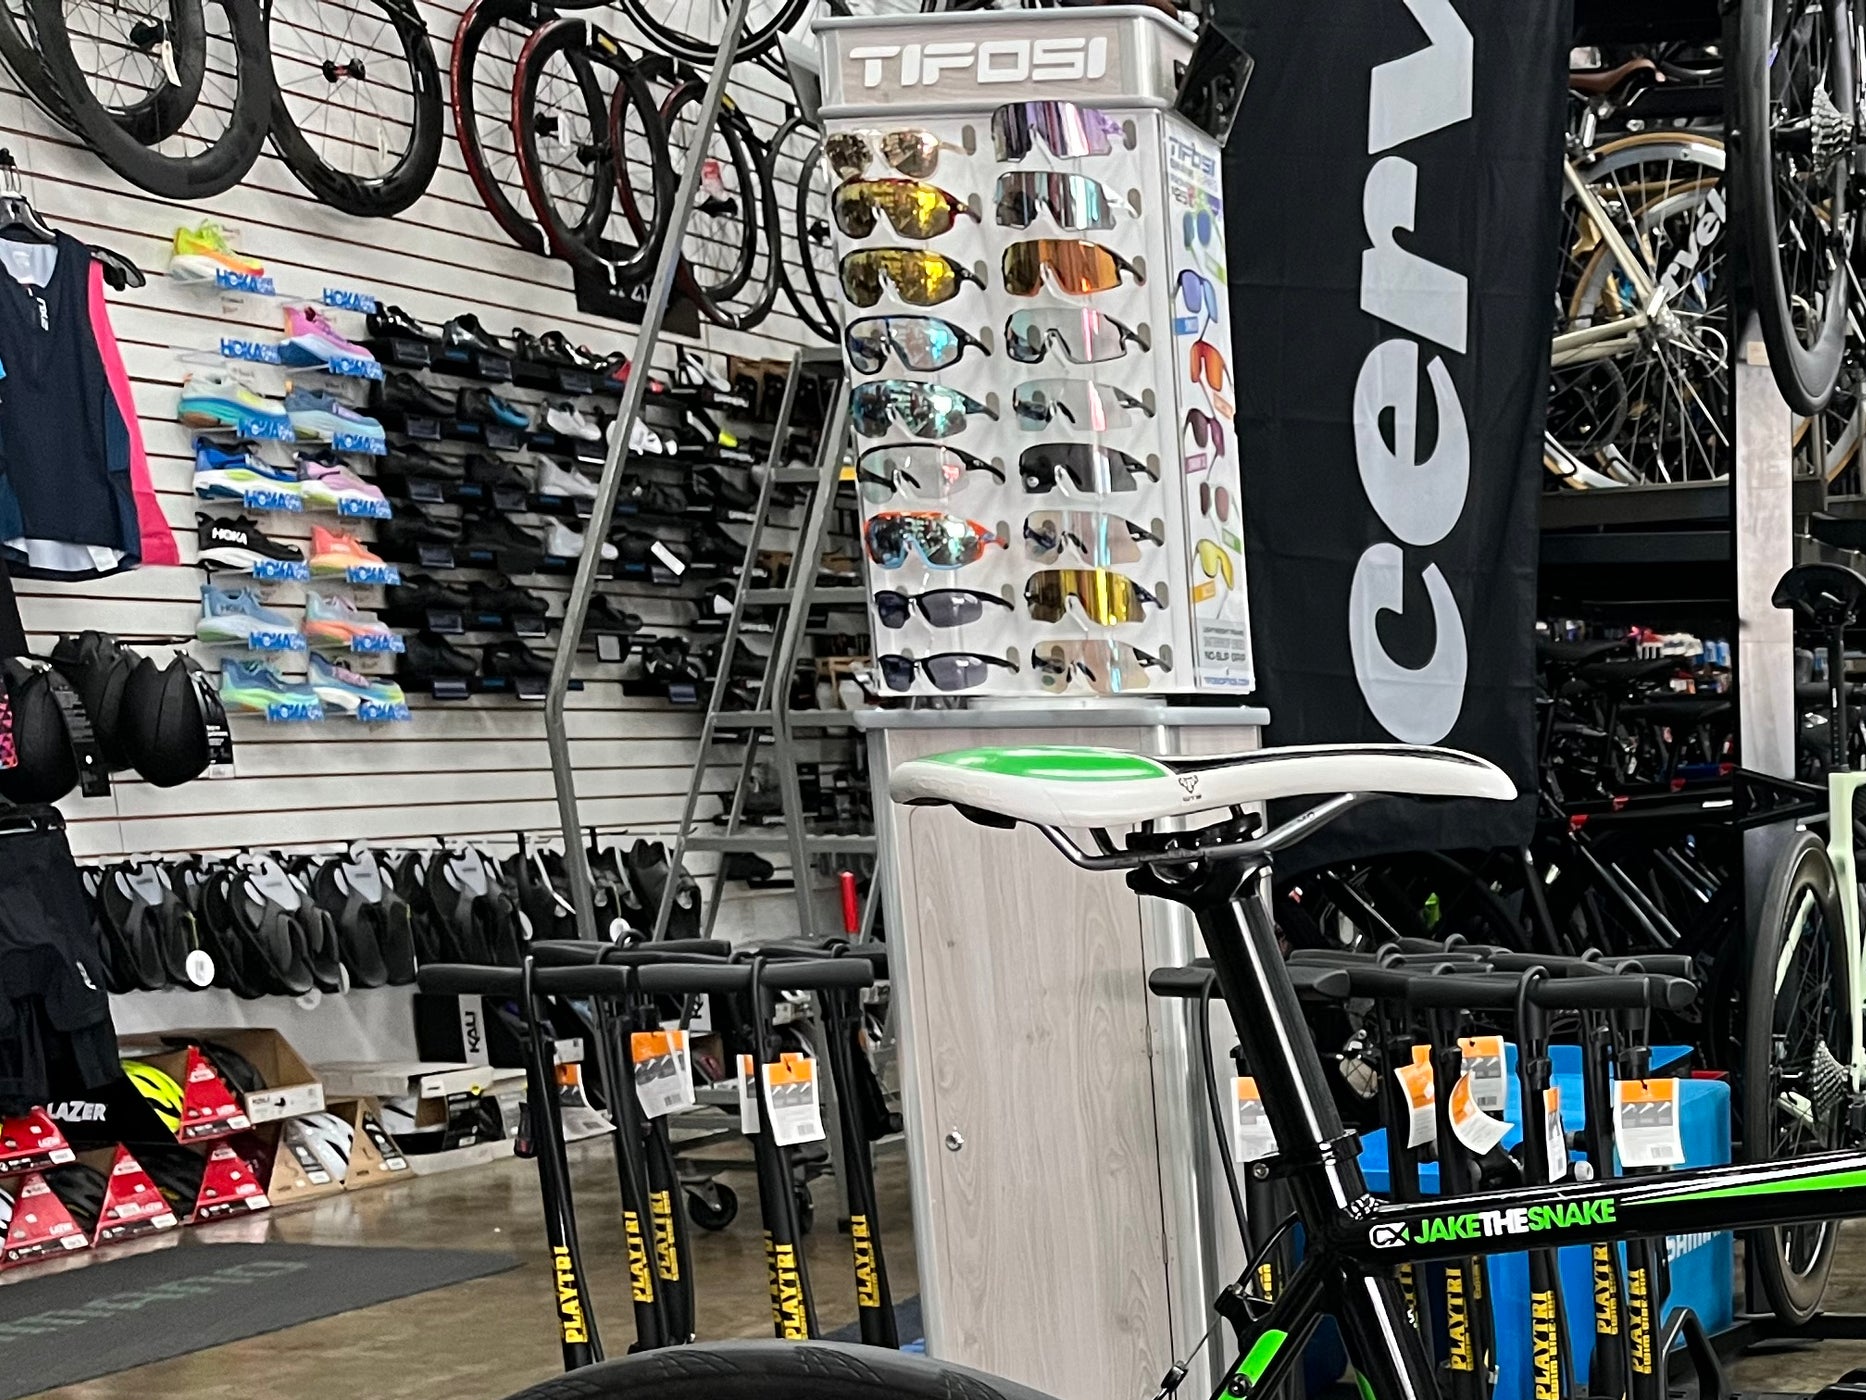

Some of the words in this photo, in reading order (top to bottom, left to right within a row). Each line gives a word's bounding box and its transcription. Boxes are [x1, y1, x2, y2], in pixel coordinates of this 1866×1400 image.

[849, 36, 1107, 88] TIFOSI
[211, 526, 248, 546] HOKA
[464, 1011, 481, 1053] KALI
[47, 1100, 107, 1122] LAZER
[553, 1245, 583, 1344] PLAYTRI
[624, 1211, 648, 1303] PLAYTRI
[776, 1243, 803, 1341] PLAYTRI
[851, 1214, 874, 1307] PLAYTRI
[1593, 1243, 1612, 1335] PLAYTR
[1445, 1267, 1467, 1371] PLAYTRI
[1530, 1290, 1551, 1400] PLAYTRI
[1627, 1268, 1645, 1373] PLAYTRI
